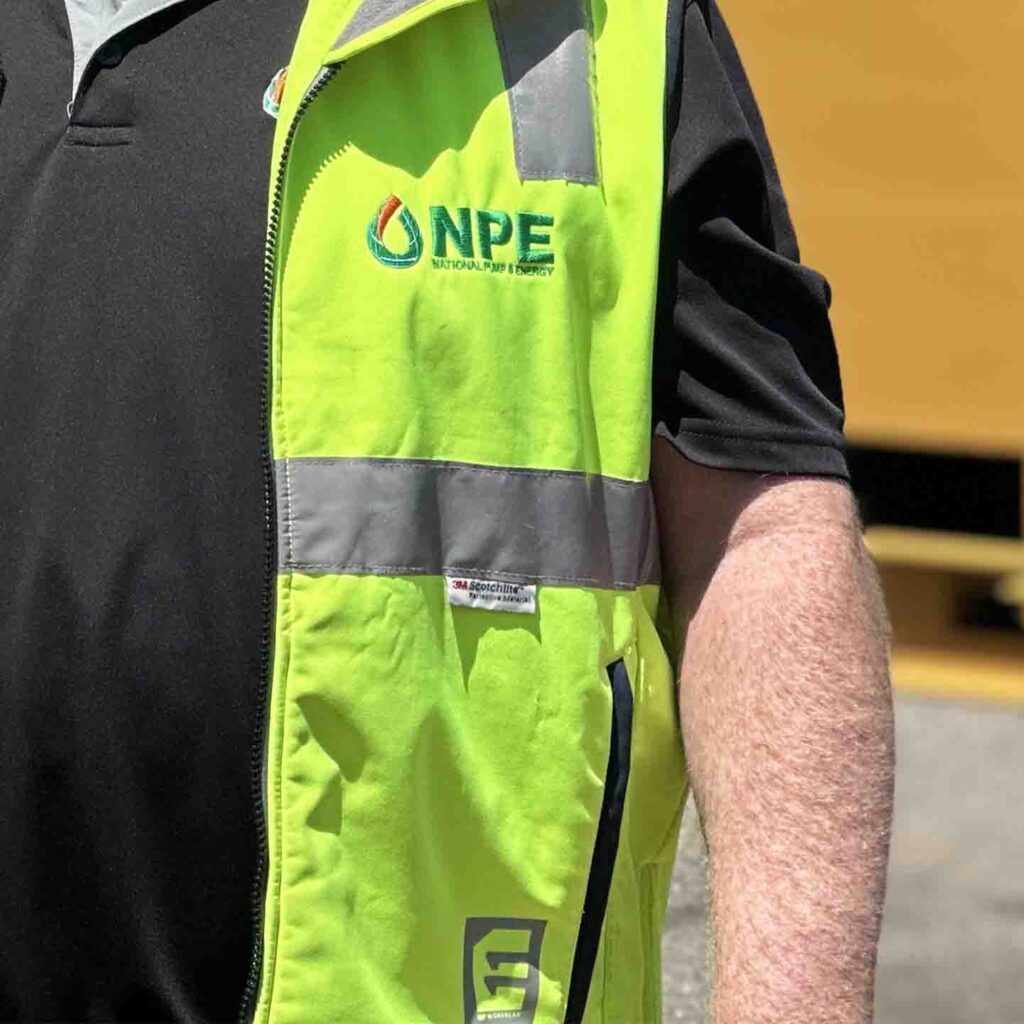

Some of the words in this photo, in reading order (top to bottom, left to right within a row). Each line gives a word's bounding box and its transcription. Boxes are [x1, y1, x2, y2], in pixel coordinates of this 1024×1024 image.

[429, 205, 555, 265] NPE
[432, 259, 483, 271] NATIONAL
[515, 265, 555, 276] ENERGY
[452, 580, 468, 590] 3M
